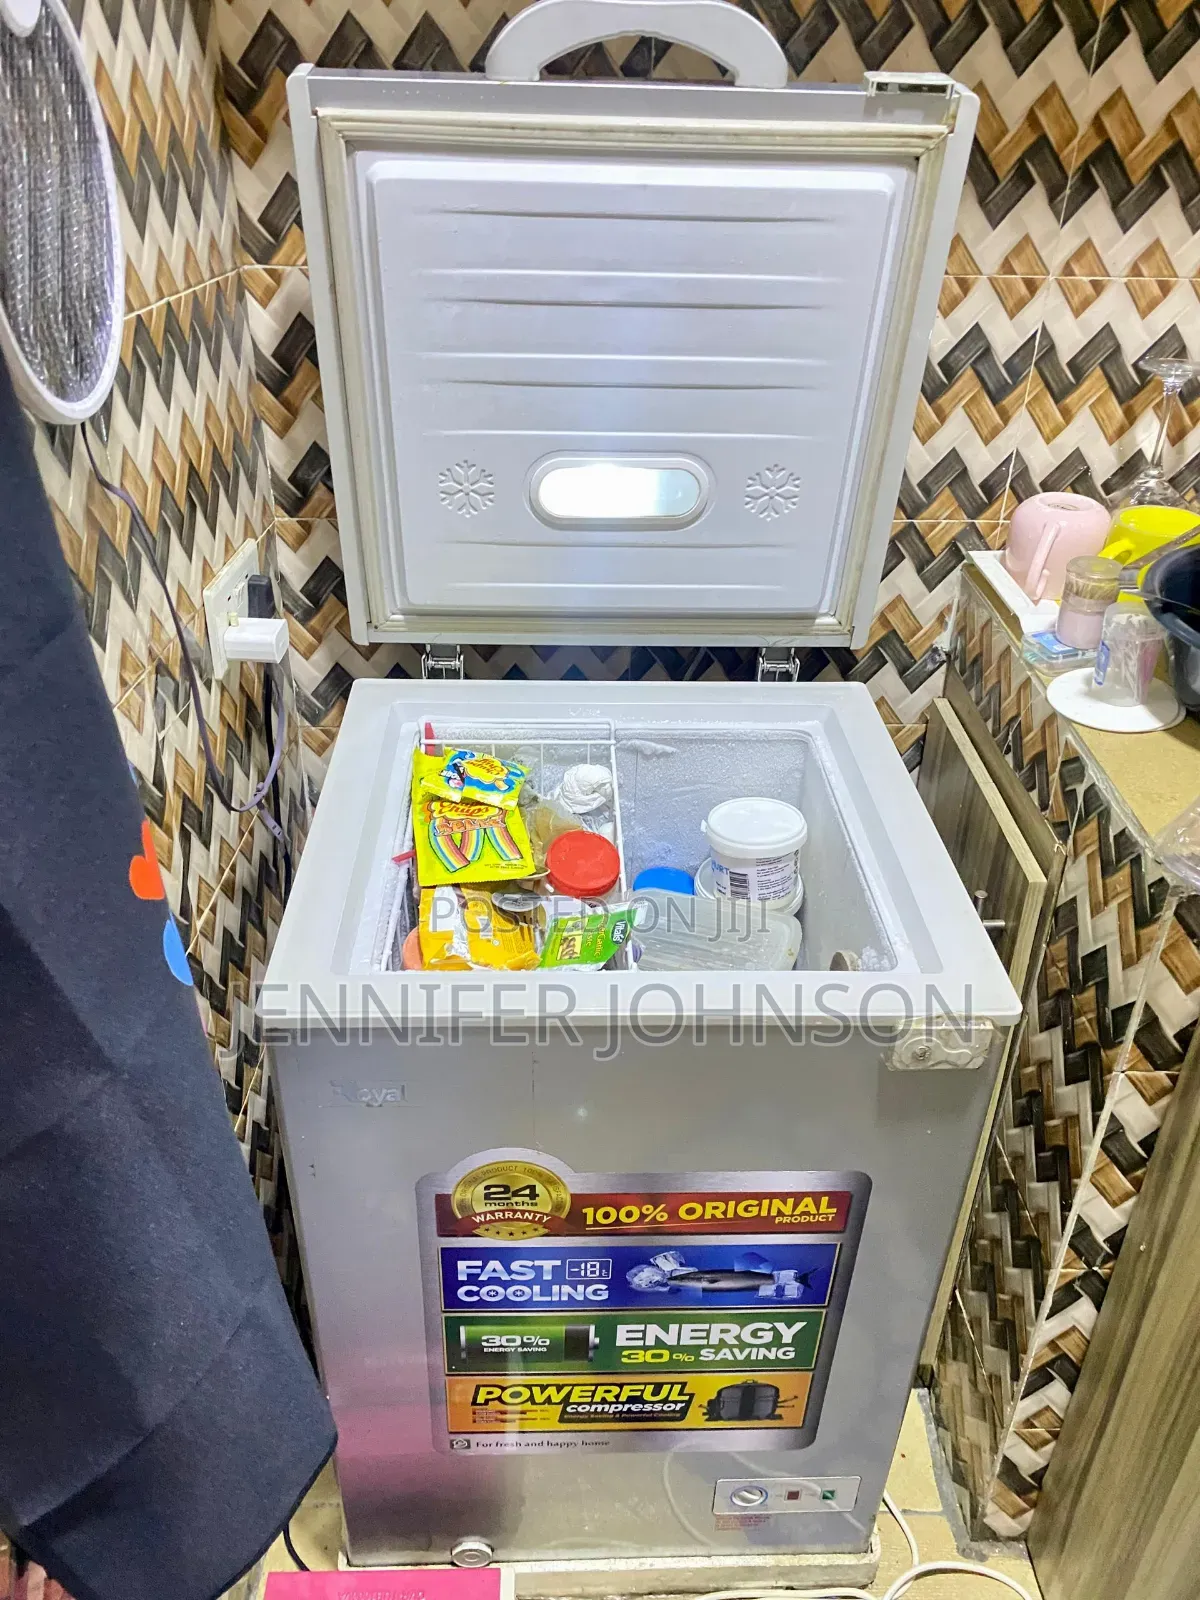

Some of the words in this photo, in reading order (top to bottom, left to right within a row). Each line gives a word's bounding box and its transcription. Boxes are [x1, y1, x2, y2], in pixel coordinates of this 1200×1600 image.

[484, 1184, 539, 1201] 24
[472, 1211, 552, 1223] WARRANTY
[582, 1204, 668, 1225] 100%
[678, 1196, 837, 1221] ORIGINAL
[775, 1214, 836, 1224] PRODUCT
[457, 1260, 561, 1281] FAST
[457, 1284, 609, 1302] COOLING
[481, 1335, 550, 1347] 30%
[616, 1321, 807, 1346] ENERGY
[699, 1347, 796, 1361] SAVING
[477, 1384, 691, 1405] POWERFUL
[566, 1402, 686, 1414] compressor
[495, 1439, 522, 1448] fresh
[524, 1439, 544, 1448] and
[546, 1439, 579, 1449] happy
[581, 1438, 610, 1446] home
